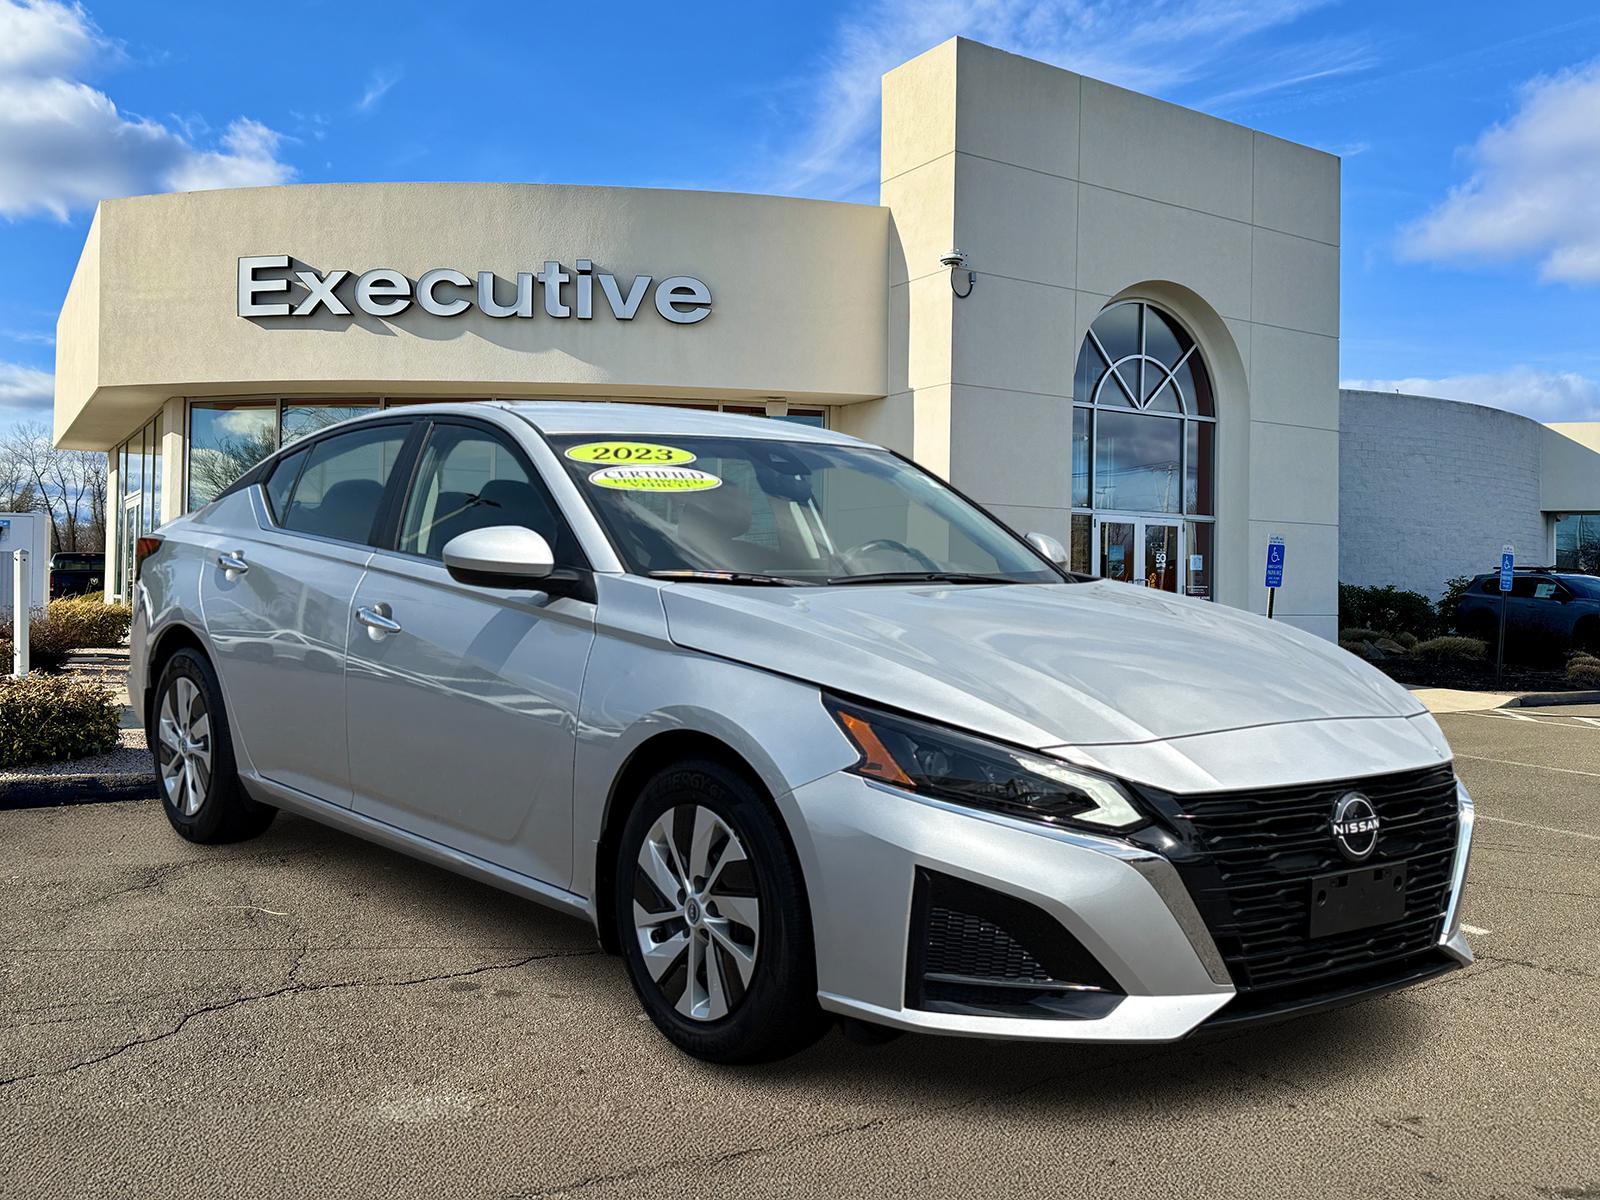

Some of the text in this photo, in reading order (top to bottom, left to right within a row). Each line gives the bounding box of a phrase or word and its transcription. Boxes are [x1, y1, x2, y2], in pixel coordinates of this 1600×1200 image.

[237, 254, 713, 325] Executive
[592, 447, 673, 461] 2023
[603, 470, 705, 480] CERTIFIED
[1333, 818, 1380, 835] NISSAN
